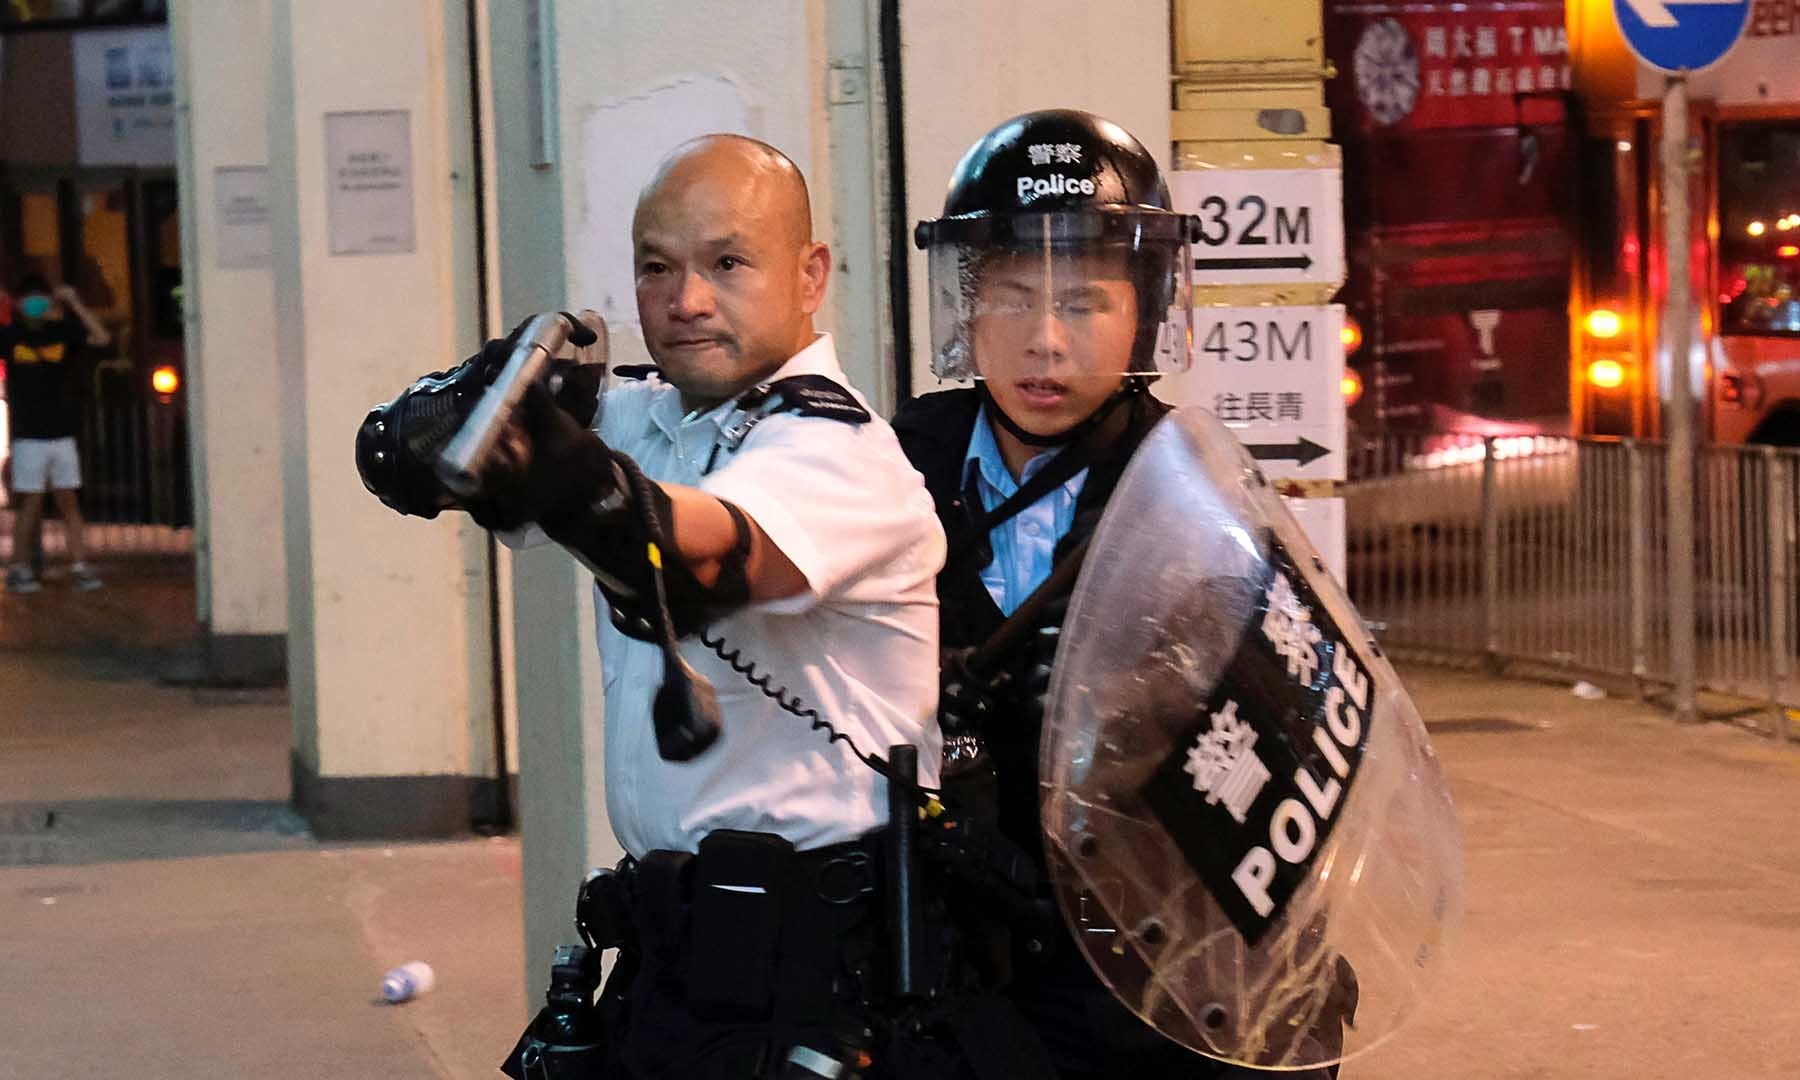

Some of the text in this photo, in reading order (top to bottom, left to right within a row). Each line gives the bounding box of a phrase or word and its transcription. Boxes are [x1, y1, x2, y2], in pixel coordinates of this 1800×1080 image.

[1029, 142, 1082, 165] 警察
[1017, 173, 1095, 197] Police
[1201, 195, 1312, 245] 32M
[1201, 320, 1312, 361] 43M
[1213, 390, 1304, 421] 往長青
[1183, 571, 1321, 824] 警察
[1231, 641, 1368, 918] POLICE
